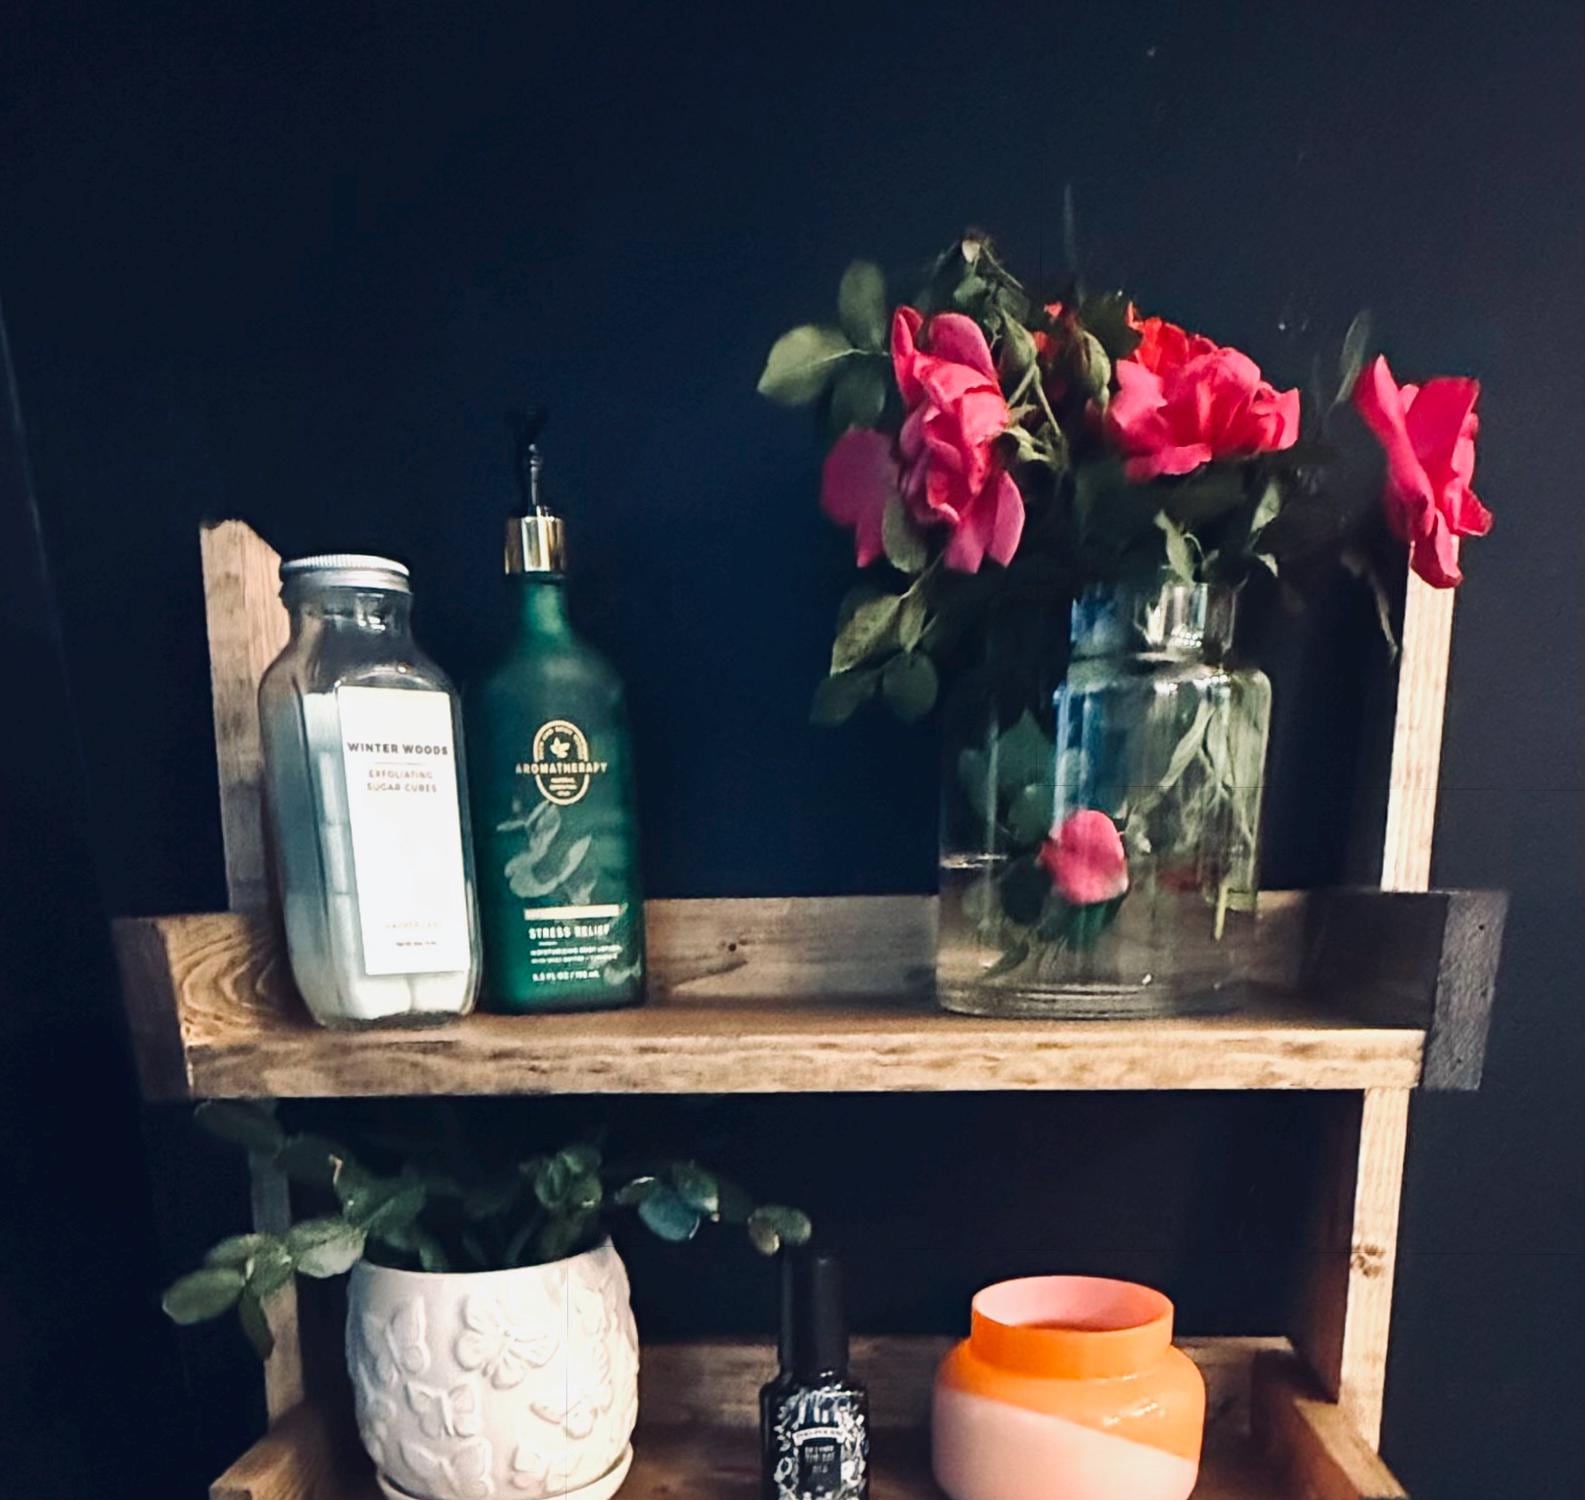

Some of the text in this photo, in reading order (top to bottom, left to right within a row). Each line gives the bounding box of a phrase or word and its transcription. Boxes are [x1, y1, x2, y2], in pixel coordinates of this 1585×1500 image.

[347, 743, 448, 756] WINTER WOODS
[368, 769, 433, 779] EXFOLIATING
[515, 762, 608, 774] AROMATHERAPY
[367, 782, 401, 792] SUGAR
[528, 924, 609, 939] STRESS RELIEF
